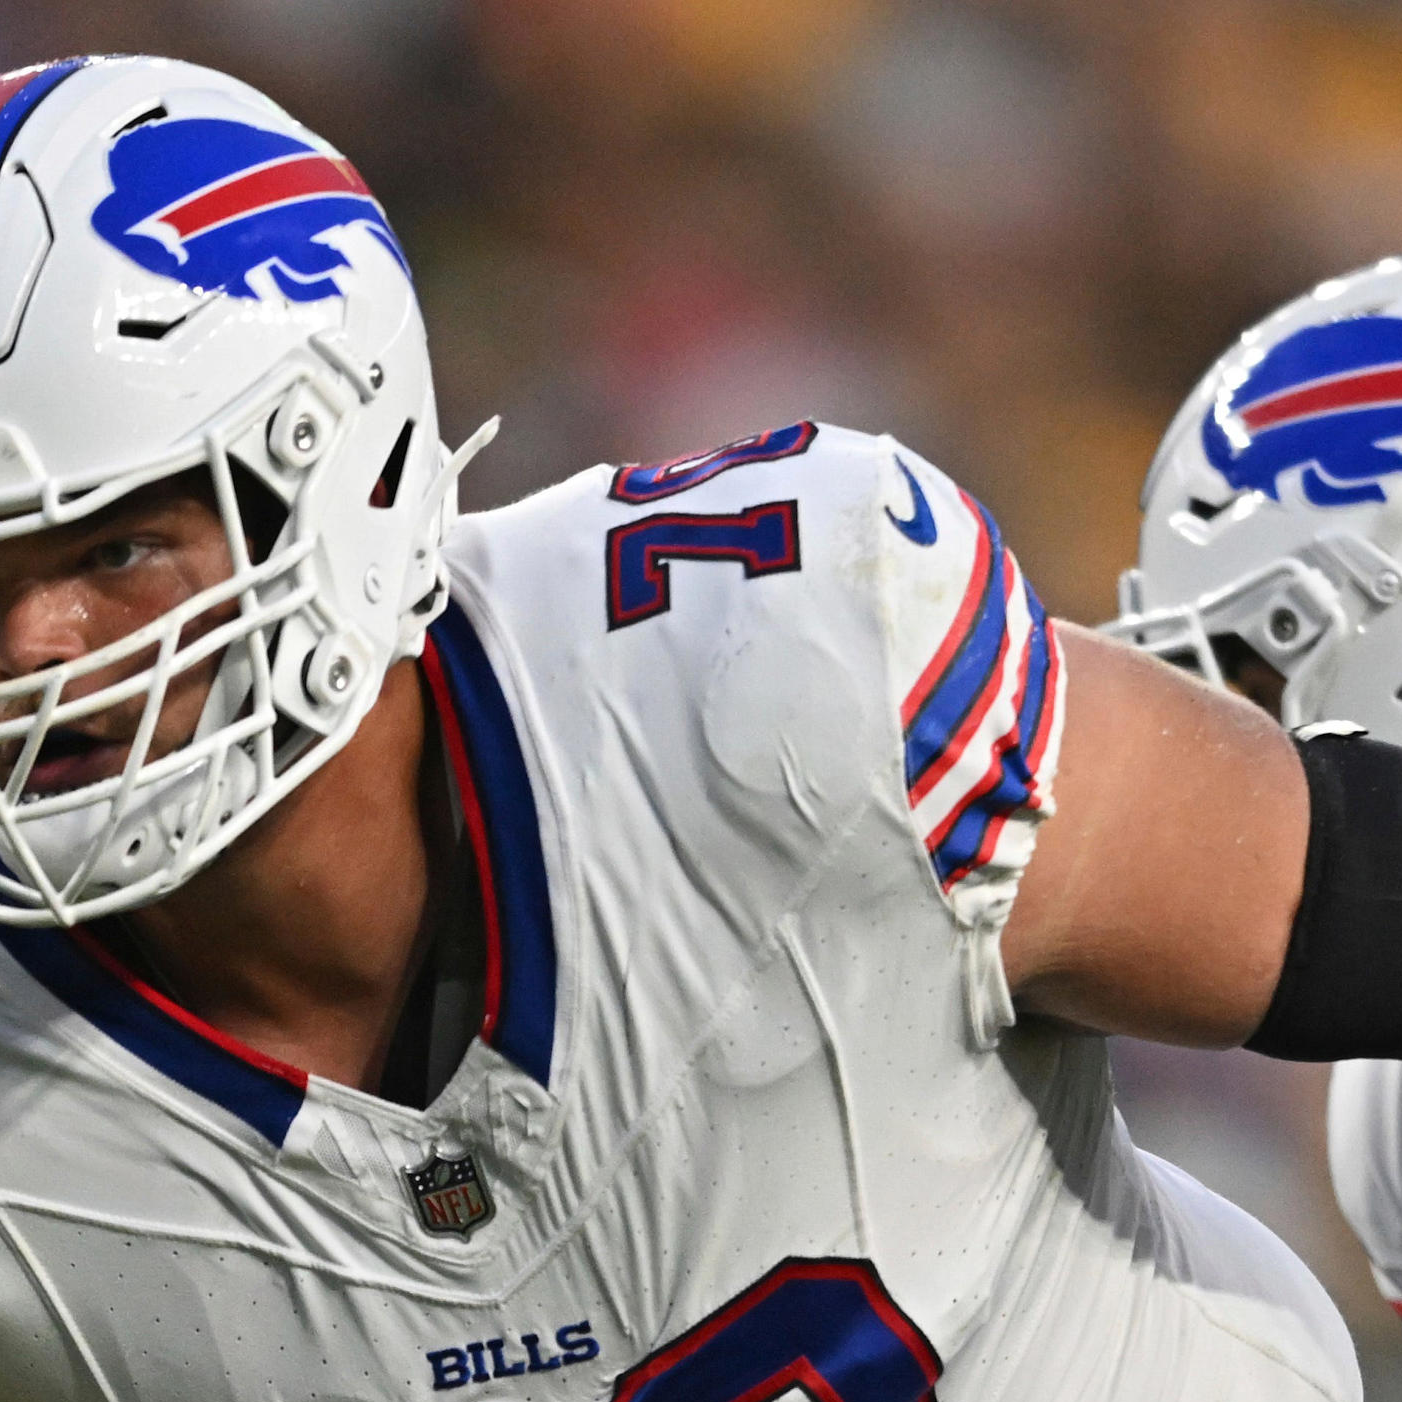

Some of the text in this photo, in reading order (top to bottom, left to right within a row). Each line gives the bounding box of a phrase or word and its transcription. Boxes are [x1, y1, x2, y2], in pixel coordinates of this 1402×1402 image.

[606, 420, 819, 633] 70
[424, 1186, 483, 1226] NFL
[426, 1320, 600, 1391] BILLS
